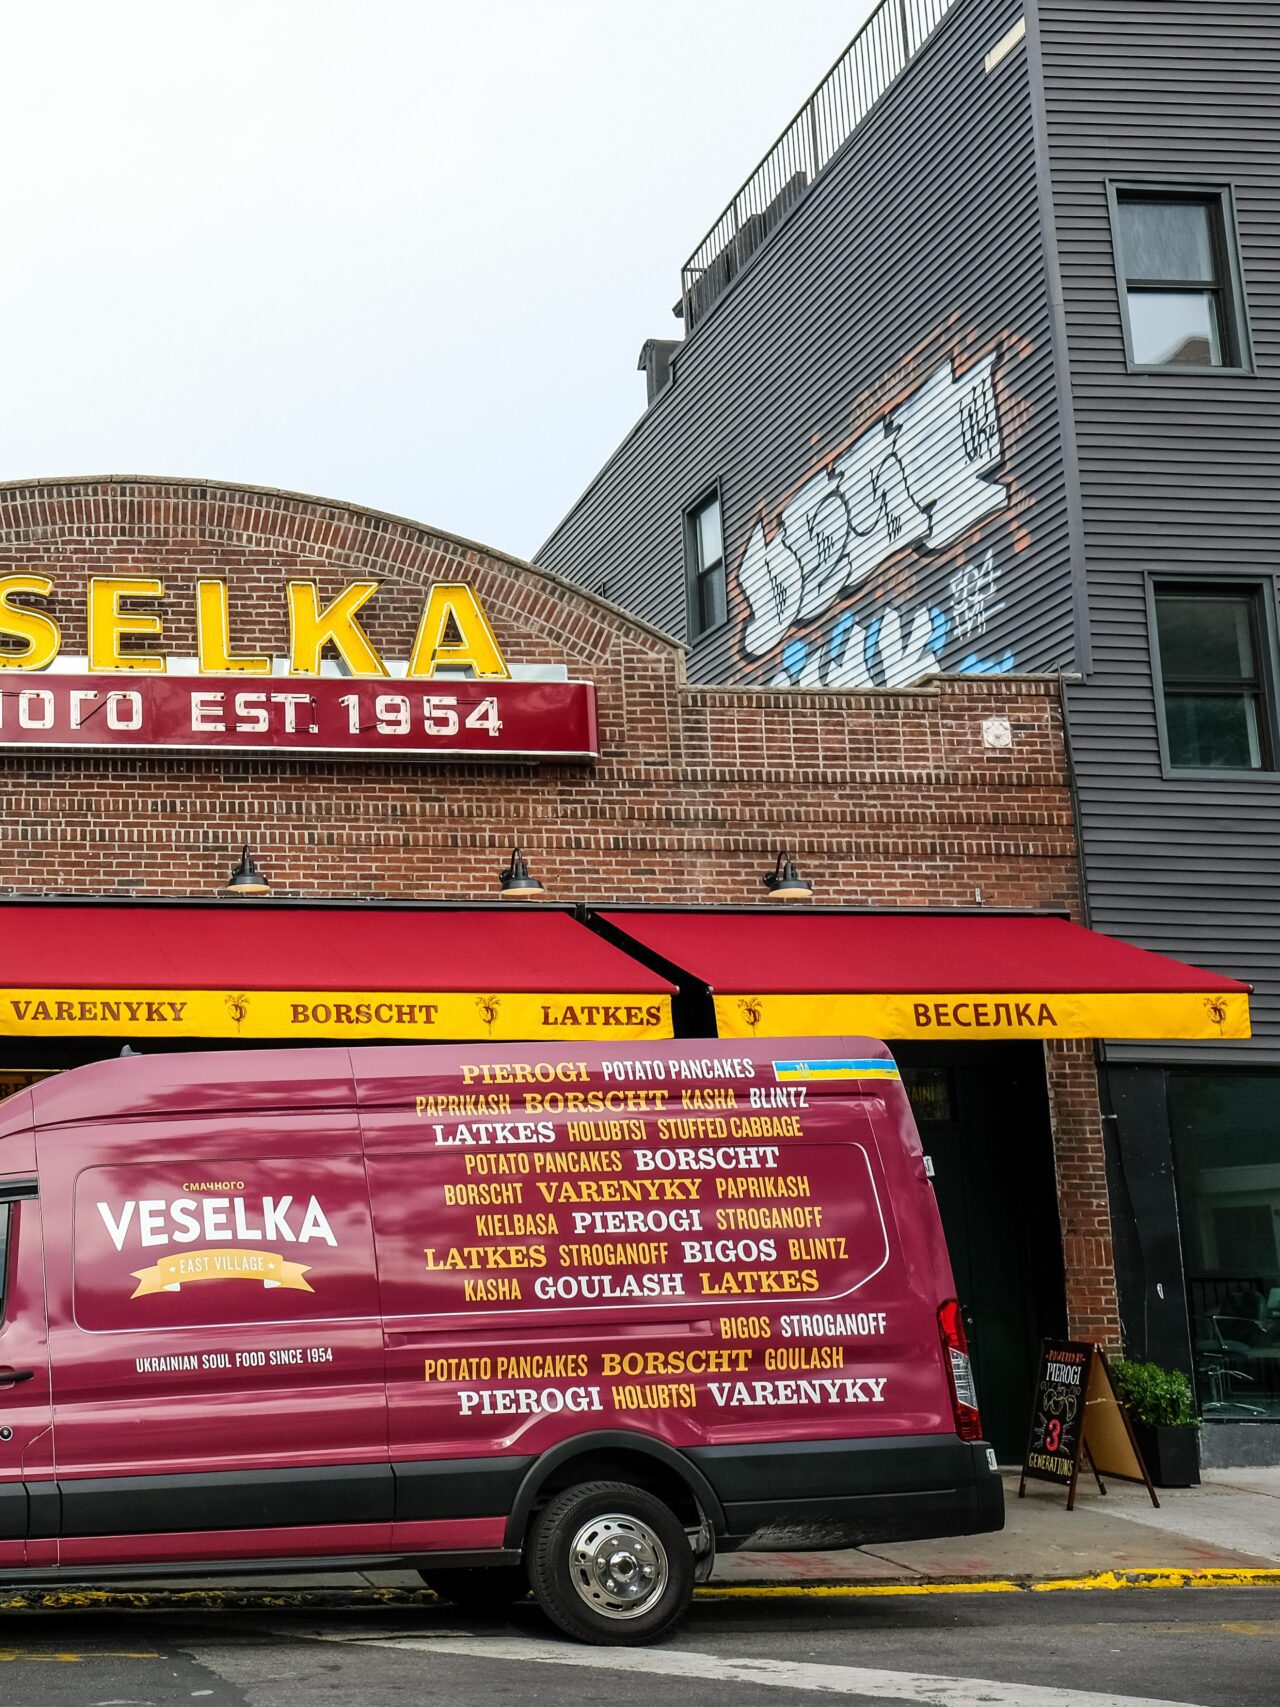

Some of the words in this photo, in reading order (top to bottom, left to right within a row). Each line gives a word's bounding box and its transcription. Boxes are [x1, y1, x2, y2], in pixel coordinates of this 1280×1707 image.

[191, 691, 319, 735] EST.
[339, 693, 503, 737] 1954
[10, 1000, 188, 1022] VARENYKY
[290, 1003, 439, 1026] BORSCHT
[540, 1005, 662, 1028] LATKES
[914, 1001, 1058, 1028] ВЕСЕЛКА
[460, 1062, 591, 1085] PIEROGI
[602, 1060, 666, 1082] POTATO
[669, 1058, 756, 1080] PANCAKES
[416, 1094, 512, 1118] PAPRIKASH
[524, 1090, 670, 1114] BORSCHT
[681, 1088, 738, 1110] KASHA
[750, 1087, 809, 1109] BLINTZ
[434, 1122, 556, 1146] LATKES
[567, 1120, 646, 1142] HOLUBTSI
[658, 1117, 728, 1140] STUFFED
[730, 1115, 804, 1138] CABBAGE
[465, 1152, 530, 1176] POTATO
[534, 1150, 622, 1174] PANCAKES
[634, 1146, 780, 1171] BORSCHT
[182, 1180, 245, 1192] СМАЧНОГО
[444, 1182, 524, 1206] BORSCHT
[536, 1178, 703, 1204] VARENYKY
[716, 1176, 810, 1199] PAPRIKASH
[96, 1195, 338, 1252] VESELKA
[475, 1212, 559, 1237] KIELBASA
[572, 1209, 704, 1234] PIEROGI
[716, 1206, 824, 1232] STROGANOFF
[179, 1257, 210, 1274] EAST
[214, 1256, 265, 1272] VILLAGE
[424, 1246, 548, 1272] LATKES
[558, 1242, 669, 1267] STROGANOFF
[680, 1238, 778, 1265] BIGOS
[788, 1236, 848, 1262] BLINTZ
[463, 1278, 522, 1302] KASHA
[533, 1272, 684, 1300] GOULASH
[698, 1269, 820, 1295] LATKES
[720, 1316, 772, 1340] BIGOS
[780, 1312, 887, 1338] STROGANOFF
[136, 1354, 199, 1374] UKRAINIAN
[202, 1354, 232, 1369] SOUL
[236, 1352, 266, 1368] FOOD
[269, 1349, 304, 1366] SINCE
[307, 1347, 334, 1363] 1954
[424, 1358, 492, 1382] POTATO
[496, 1354, 588, 1380] PANCAKES
[601, 1350, 752, 1376] BORSCHT
[764, 1346, 844, 1371] GOULASH
[1046, 1362, 1082, 1385] PIEROGI
[458, 1386, 604, 1416] PIEROGI
[612, 1384, 696, 1410] HOLUBTSI
[706, 1378, 888, 1408] VARENYKY
[1045, 1419, 1061, 1452] 3
[1029, 1453, 1074, 1476] GENERATIONS
